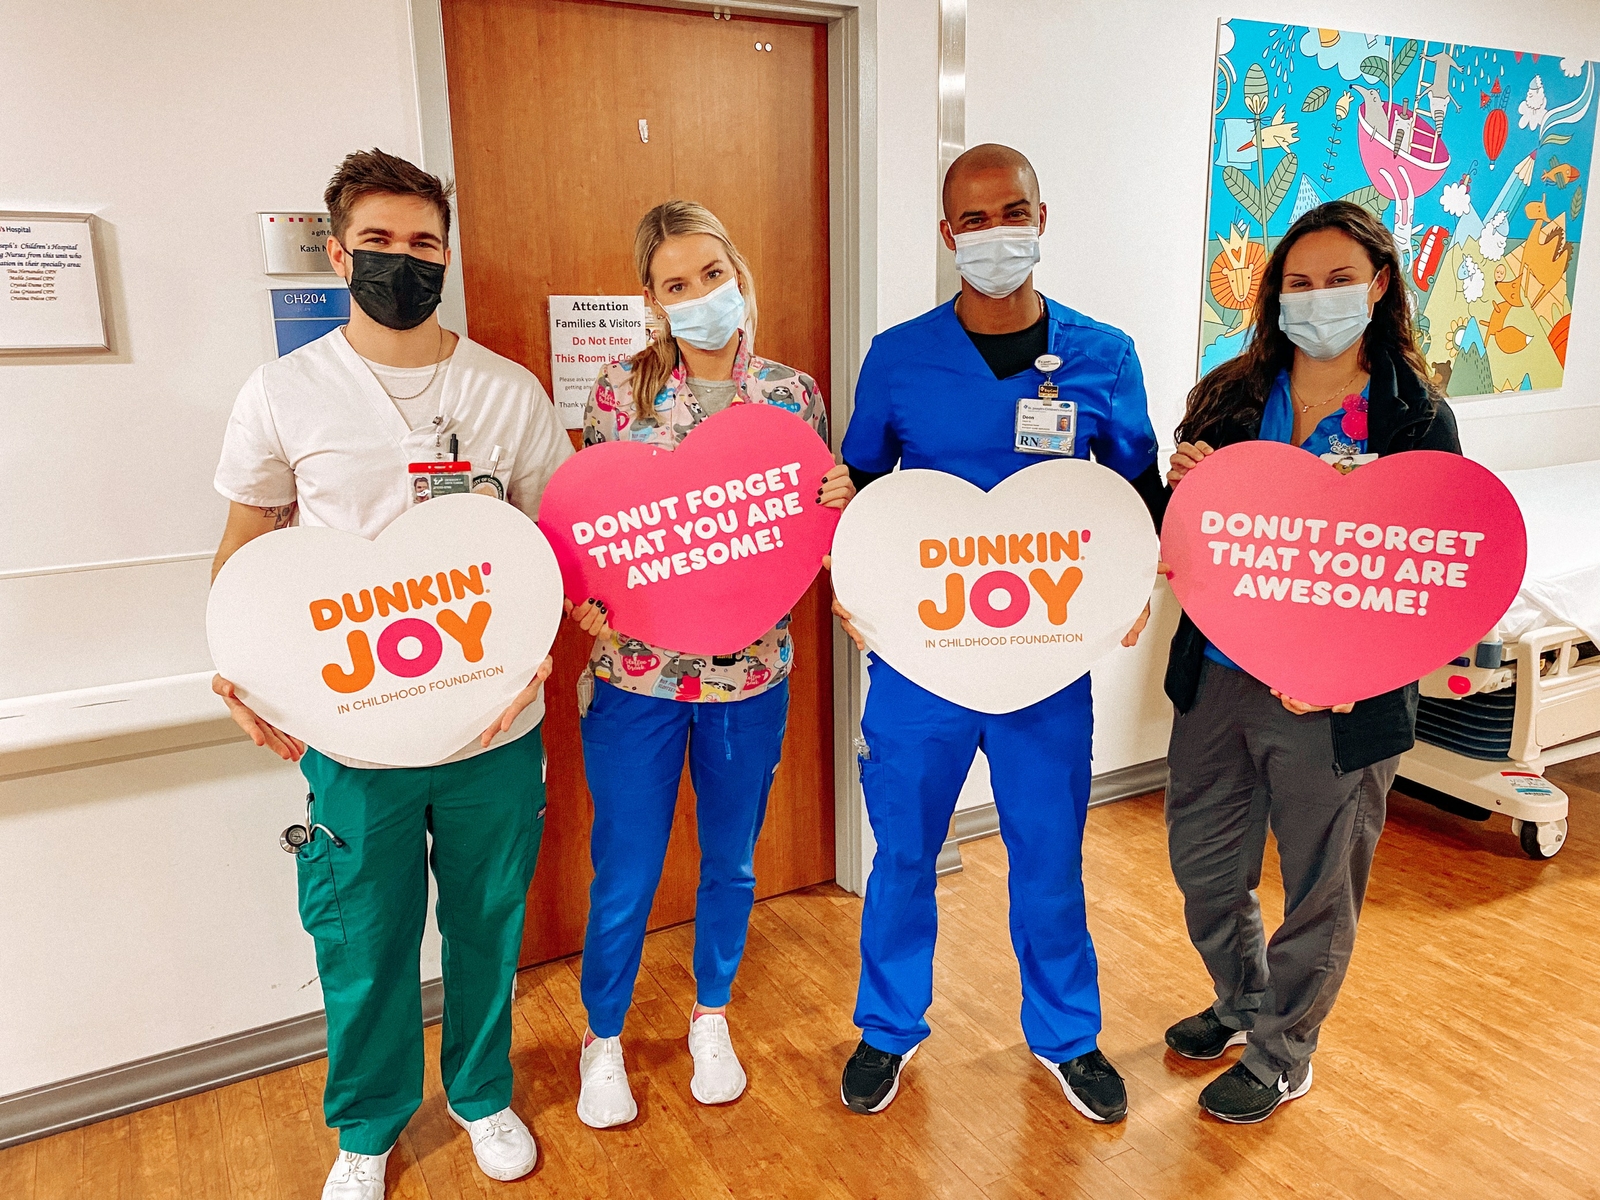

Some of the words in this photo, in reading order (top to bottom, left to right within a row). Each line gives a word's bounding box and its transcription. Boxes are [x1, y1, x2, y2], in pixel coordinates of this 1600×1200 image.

[6, 226, 31, 234] Hospital
[284, 293, 327, 304] CH204
[572, 301, 629, 311] Attention
[555, 319, 596, 328] Families
[599, 319, 607, 328] &
[609, 319, 641, 328] Visitors
[572, 337, 586, 346] Do
[588, 337, 606, 345] Not
[609, 337, 632, 345] Enter
[555, 354, 575, 363] This
[578, 354, 606, 363] Room
[608, 354, 614, 362] is
[617, 353, 631, 362] Clo
[1020, 435, 1039, 447] RN
[572, 496, 679, 545] DONUT
[685, 462, 801, 514] FORGET
[588, 529, 667, 569] THAT
[673, 509, 738, 545] YOU
[747, 492, 803, 527] ARE
[920, 530, 1091, 568] DUNKIN'
[1201, 511, 1328, 544] DONUT
[1335, 521, 1485, 557] FORGET
[627, 526, 784, 590] AWESOME!
[1208, 541, 1300, 571] THAT
[1308, 549, 1385, 580] YOU
[1394, 558, 1469, 588] ARE
[309, 562, 491, 631] DUNKIN'
[918, 567, 1083, 630] JOY
[1233, 574, 1429, 616] AWESOME!
[322, 601, 492, 693] JOY
[925, 639, 936, 648] IN
[939, 636, 1007, 648] CHILDHOOD
[1010, 633, 1083, 645] FOUNDATION
[337, 703, 350, 714] IN
[352, 685, 426, 711] CHILDHOOD
[429, 665, 504, 692] FOUNDATION
